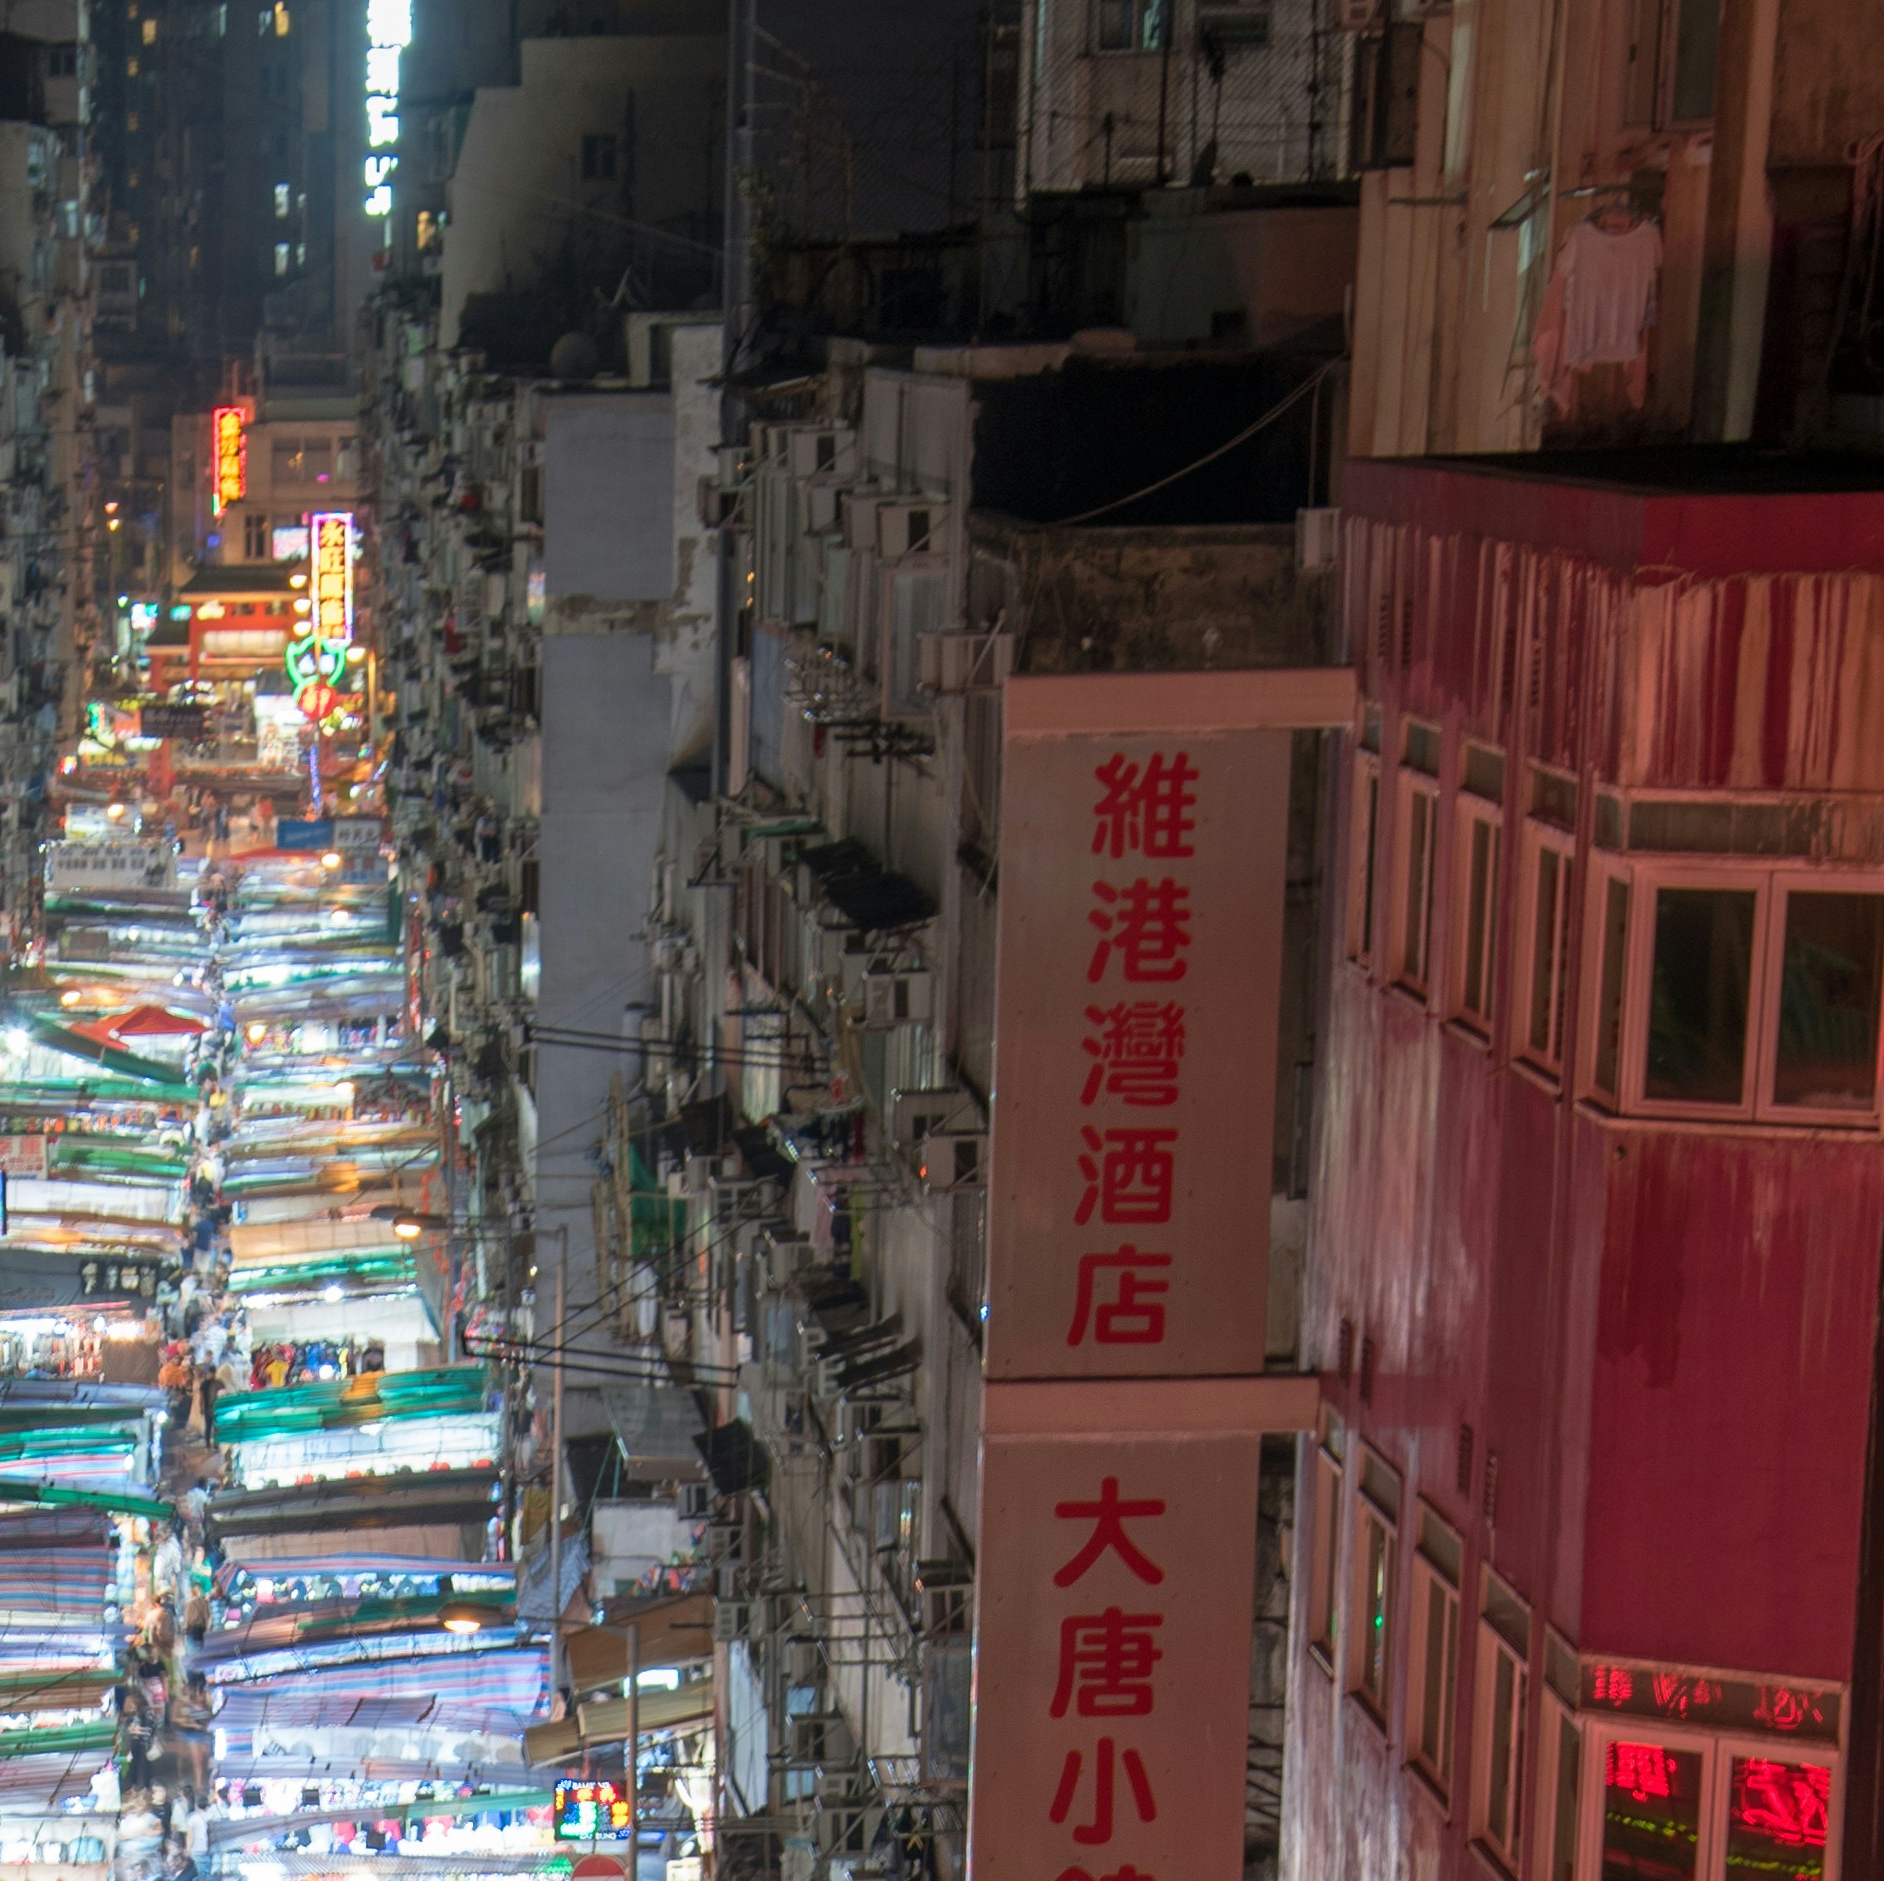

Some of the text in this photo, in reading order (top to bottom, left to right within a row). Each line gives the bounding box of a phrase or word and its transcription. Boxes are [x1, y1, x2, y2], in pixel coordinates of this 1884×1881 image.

[1065, 751, 1200, 1347] 維港灣酒店
